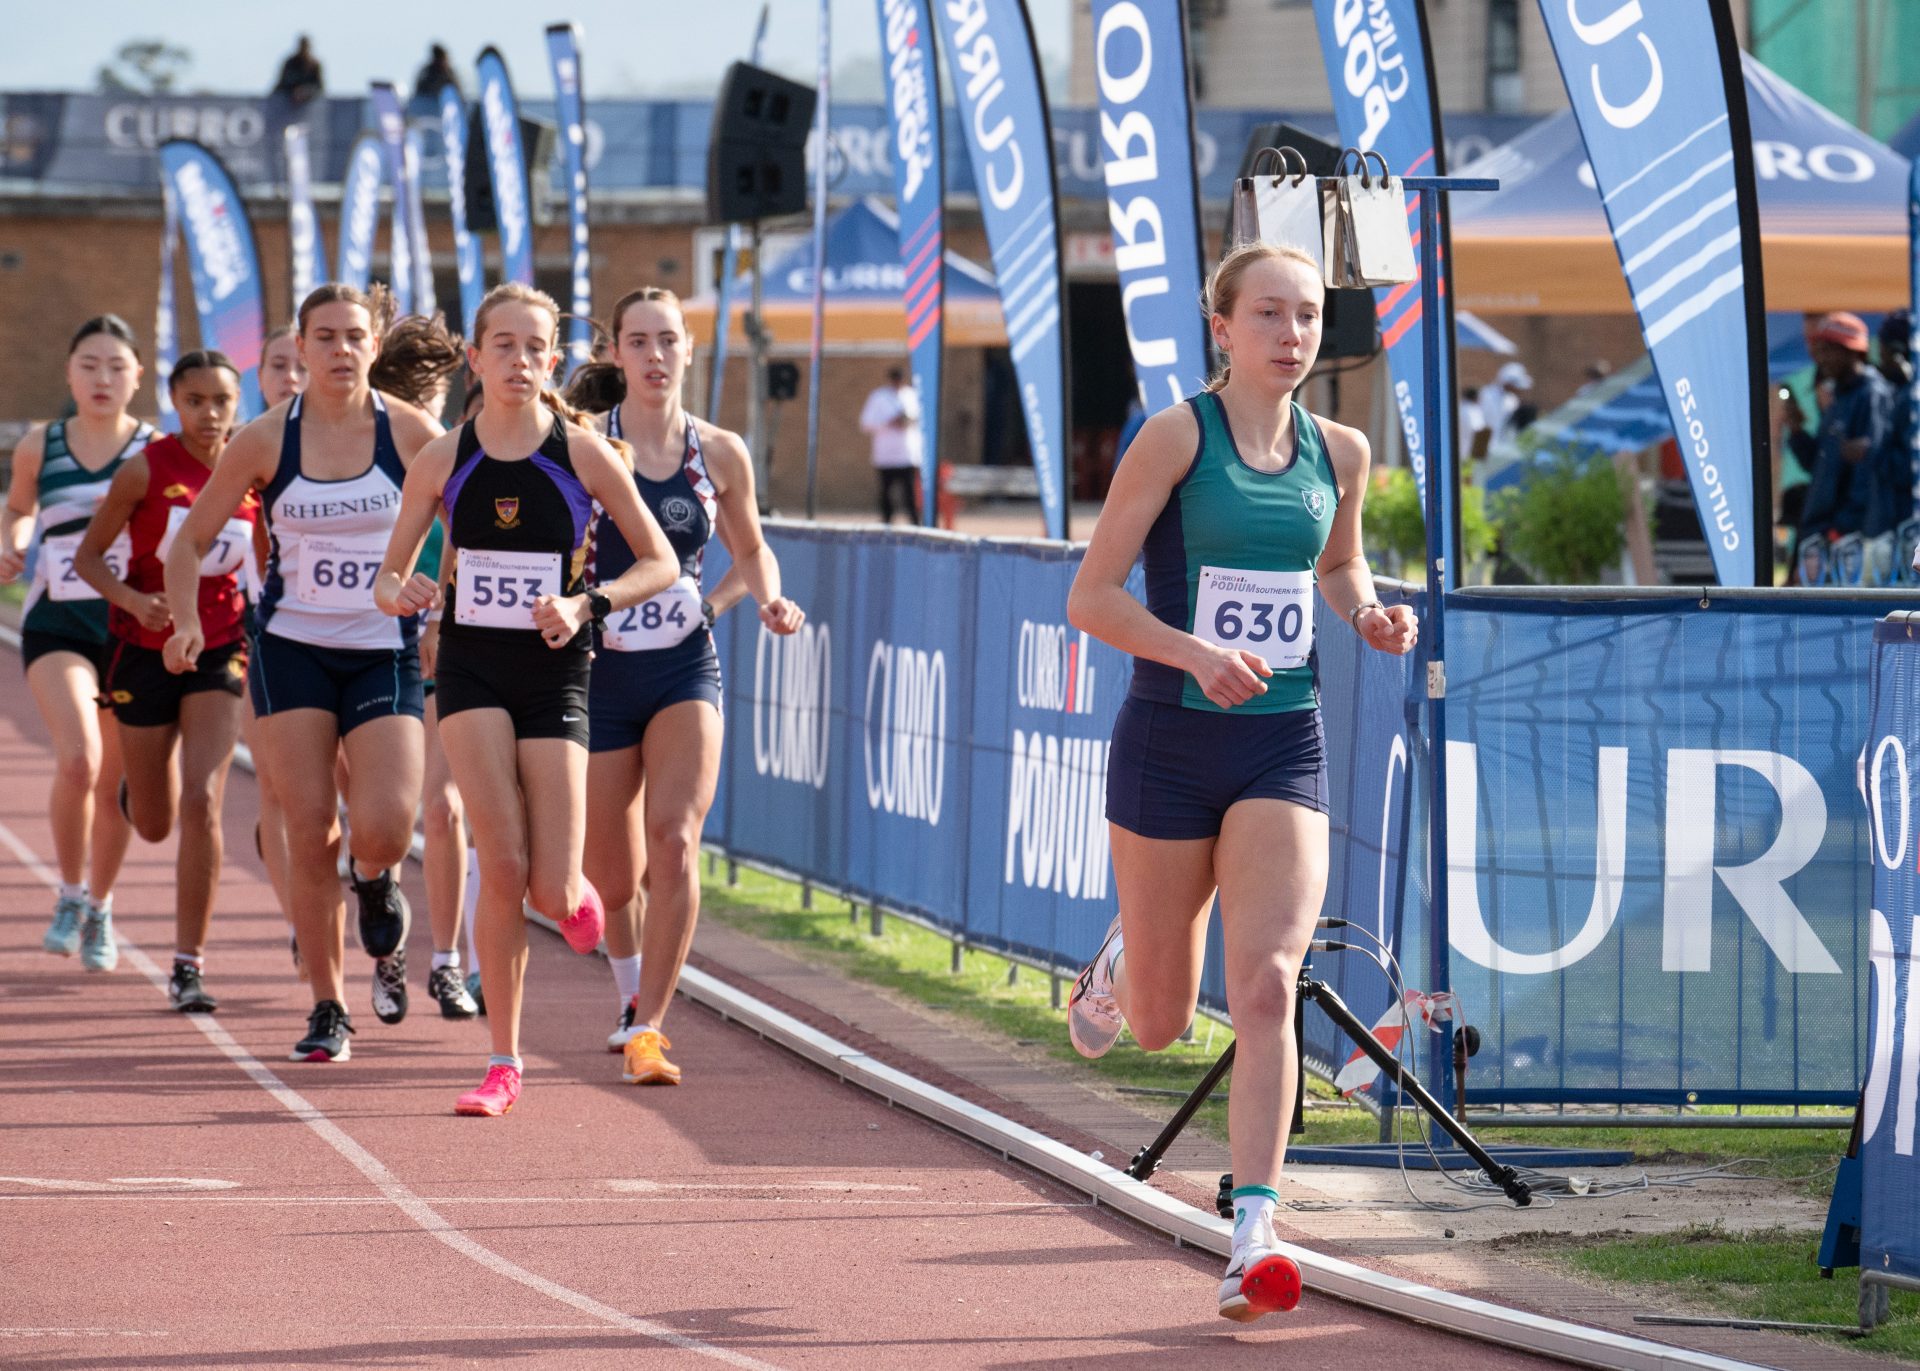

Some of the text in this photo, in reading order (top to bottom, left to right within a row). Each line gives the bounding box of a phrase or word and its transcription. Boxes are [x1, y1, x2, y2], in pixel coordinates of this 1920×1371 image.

[282, 491, 402, 519] RHENISH
[61, 556, 121, 582] 26
[313, 559, 383, 590] 687
[473, 575, 543, 609] 553
[1210, 580, 1256, 593] PODIUM
[1256, 586, 1291, 595] SOUTHERN
[618, 601, 687, 632] 284
[1214, 600, 1303, 643] 630
[1017, 619, 1067, 712] CURRO
[754, 622, 831, 790] CURRO
[864, 638, 946, 827] CURRO
